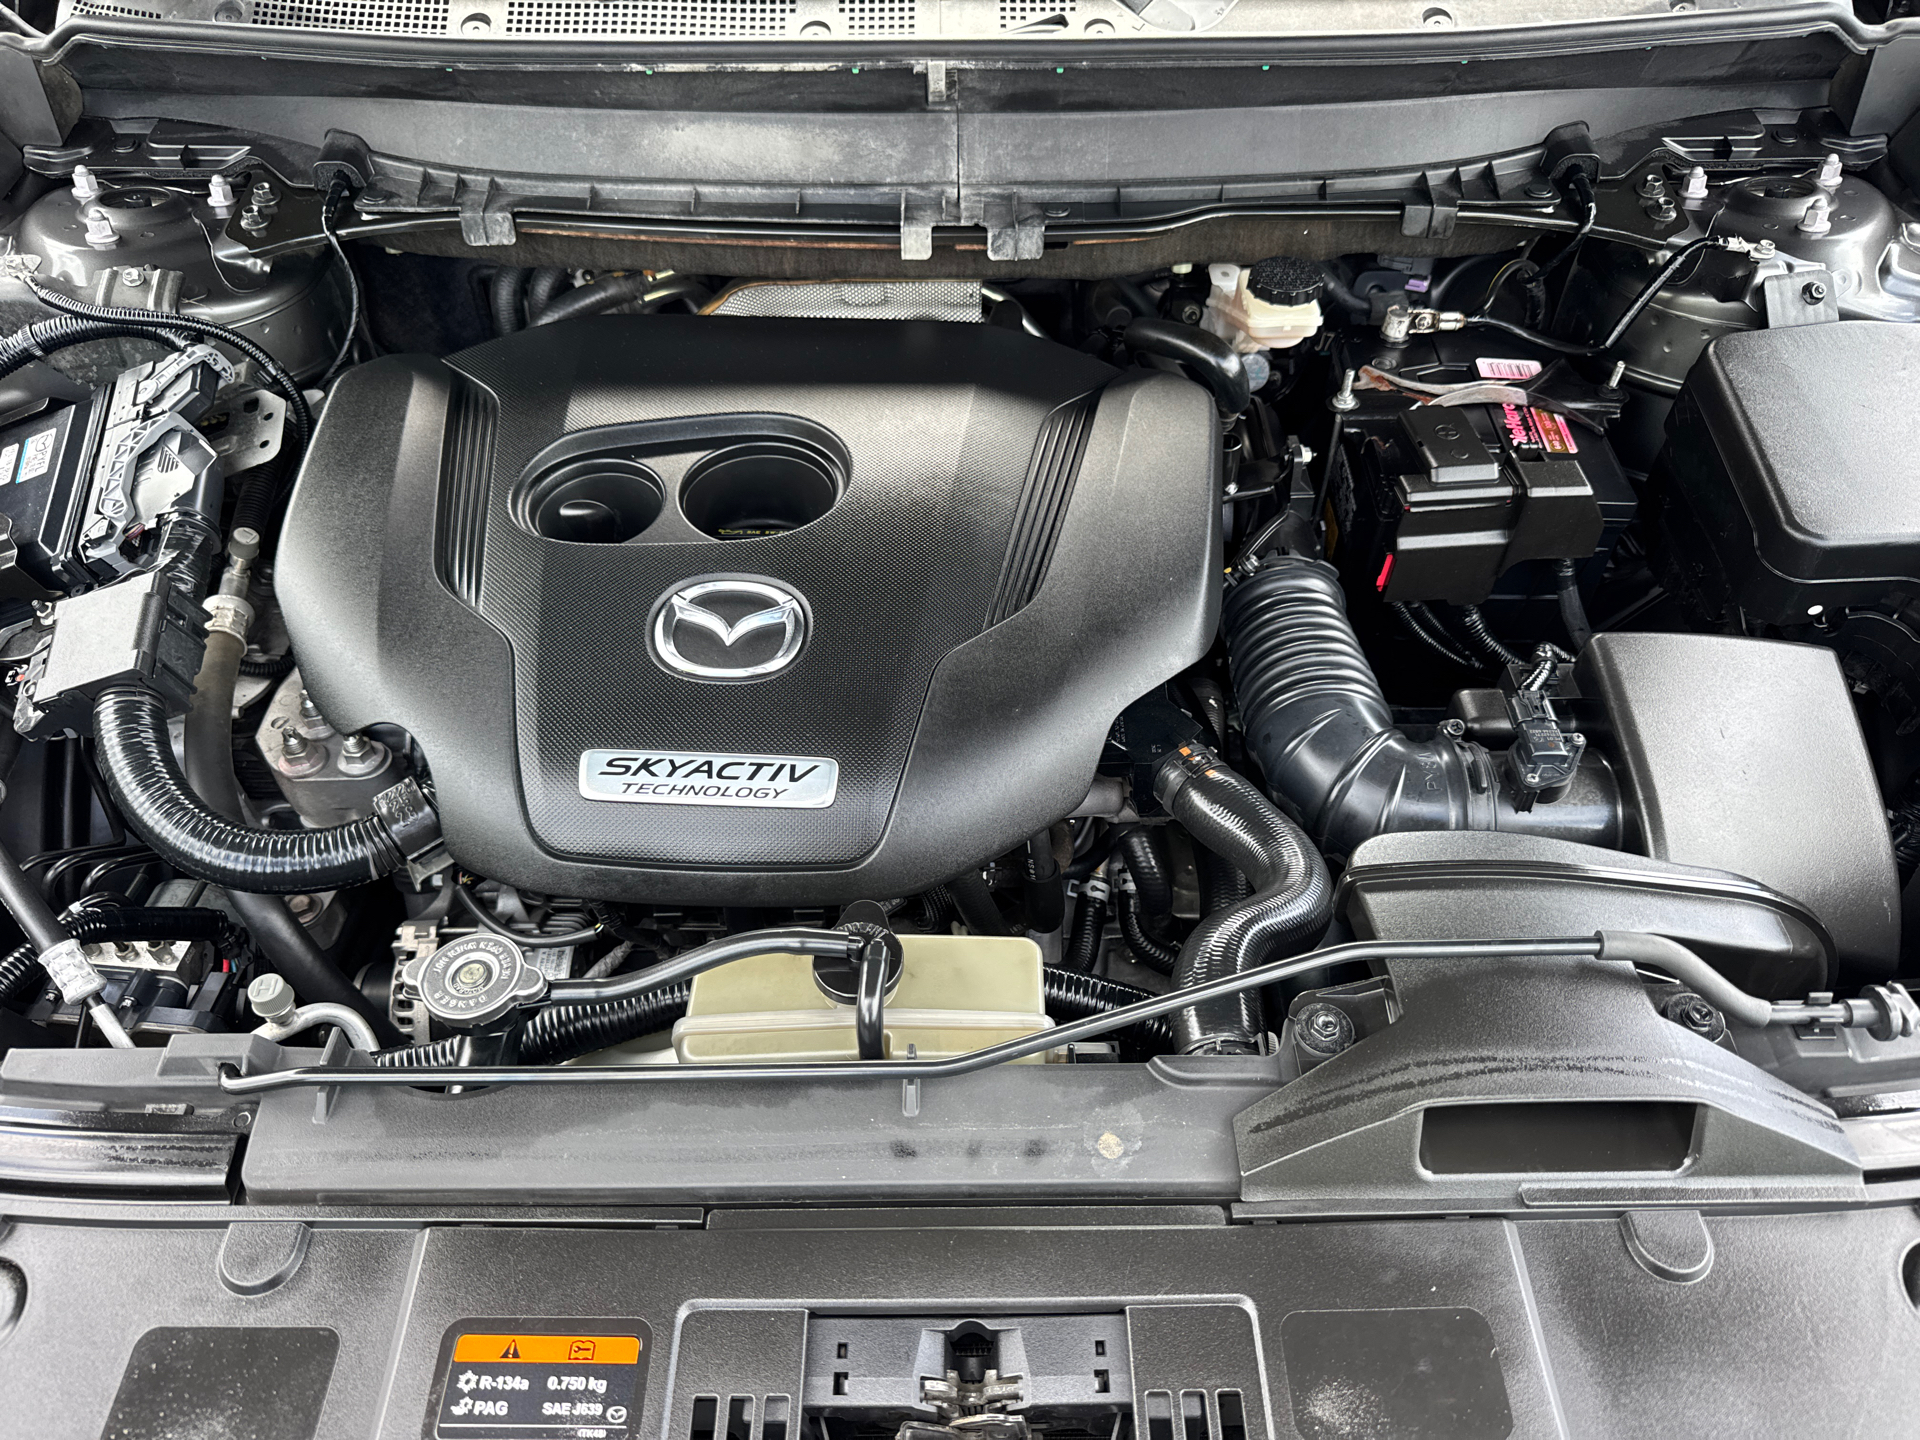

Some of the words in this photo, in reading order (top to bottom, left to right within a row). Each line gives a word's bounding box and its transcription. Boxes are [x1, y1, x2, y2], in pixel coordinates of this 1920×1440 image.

[598, 757, 820, 783] SKYACTIV
[621, 783, 789, 799] TECHNOLOGY
[434, 990, 488, 1008] DANGER
[479, 1376, 530, 1391] R-134a
[547, 1376, 586, 1391] 0.750
[587, 1376, 607, 1394] kg
[473, 1401, 509, 1416] PAG
[541, 1402, 571, 1416] SAE
[572, 1403, 603, 1416] J639
